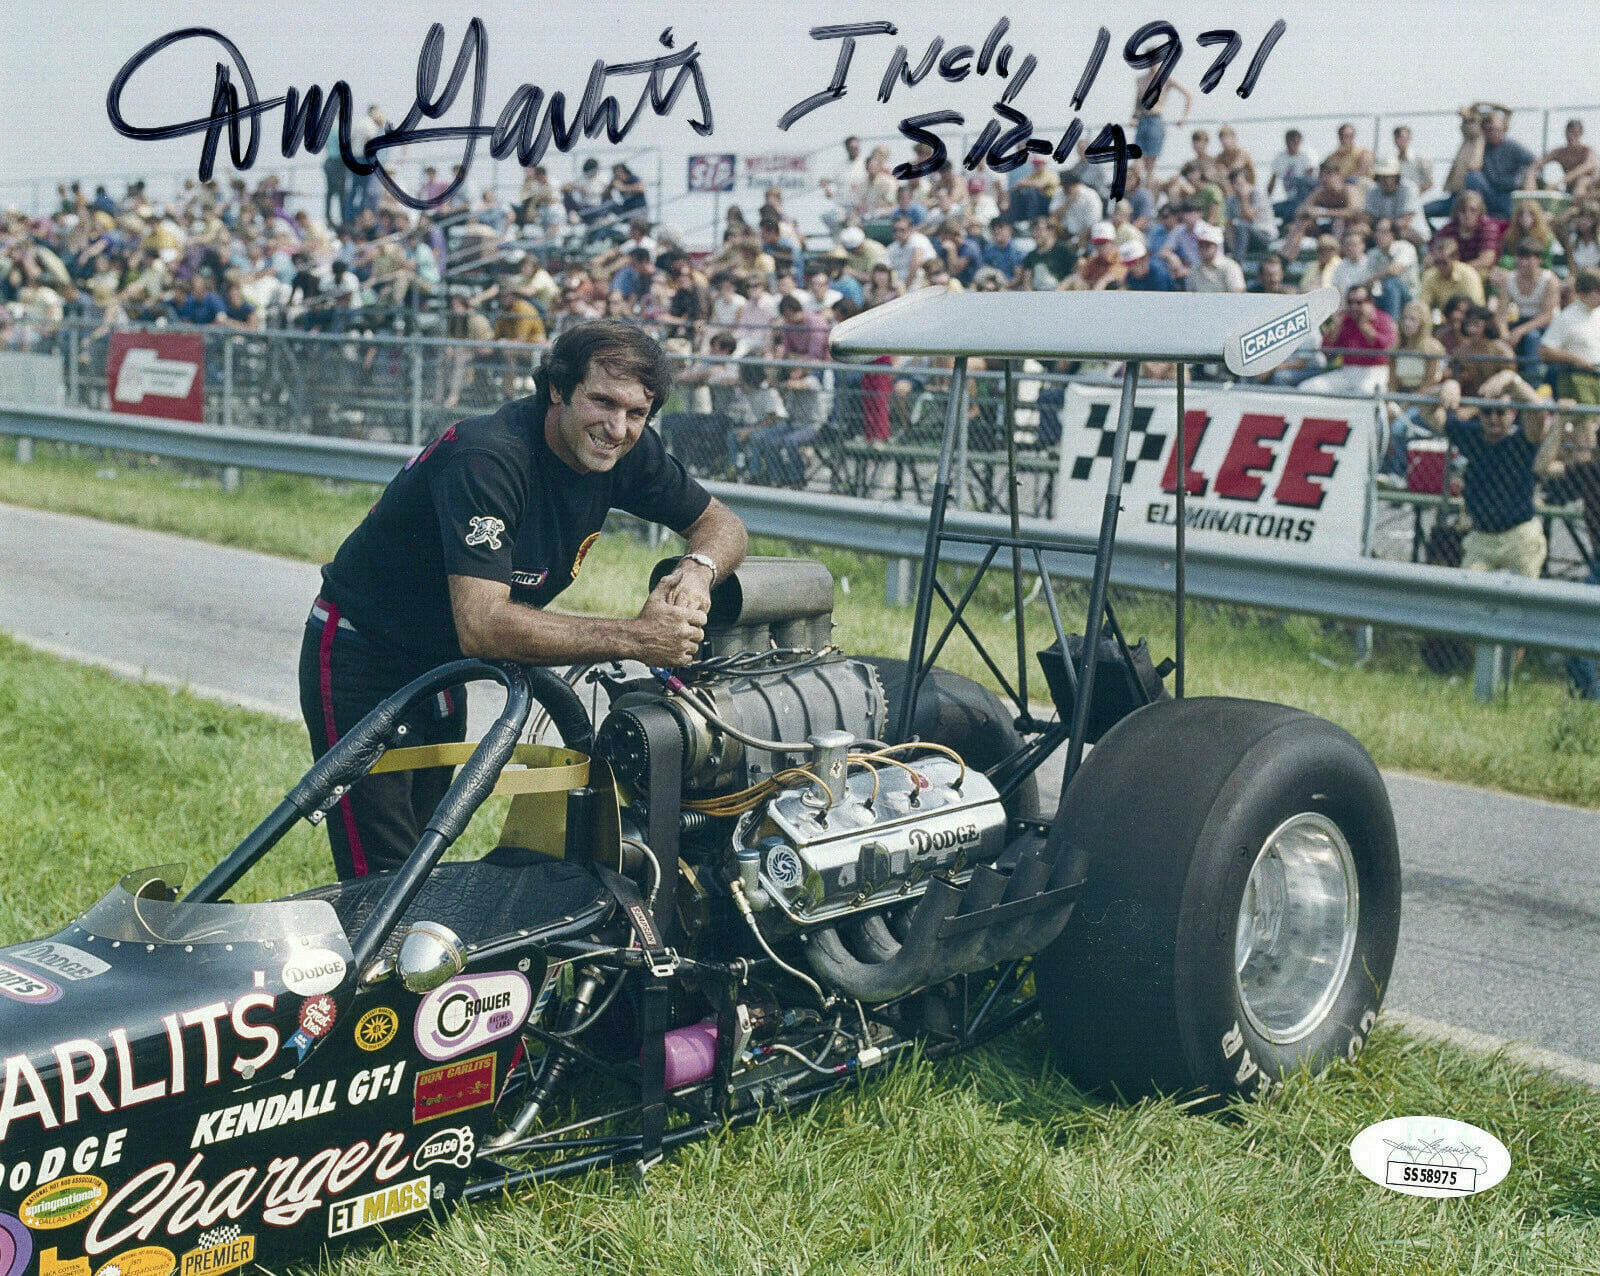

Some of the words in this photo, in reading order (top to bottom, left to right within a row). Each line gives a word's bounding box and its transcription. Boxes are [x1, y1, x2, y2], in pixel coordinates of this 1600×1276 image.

[1070, 18, 1287, 111] 1971
[1245, 313, 1307, 356] CRAGAR
[1160, 409, 1352, 511] LEE
[1147, 502, 1316, 543] ELMINATORS
[908, 823, 980, 856] DODGE
[285, 961, 344, 983] DODGE
[437, 991, 512, 1038] CROWER
[420, 1071, 443, 1086] DON
[446, 1058, 492, 1079] GARLITS
[190, 1079, 338, 1150] KENDALL
[347, 1061, 407, 1106] GT-1
[0, 1128, 128, 1192] ODGE
[423, 1138, 459, 1159] EELCO
[25, 1186, 103, 1217] springnationals
[85, 1131, 410, 1256] Charger
[332, 1201, 358, 1234] ET
[362, 1179, 428, 1224] MAGS
[185, 1240, 250, 1275] PREMIER
